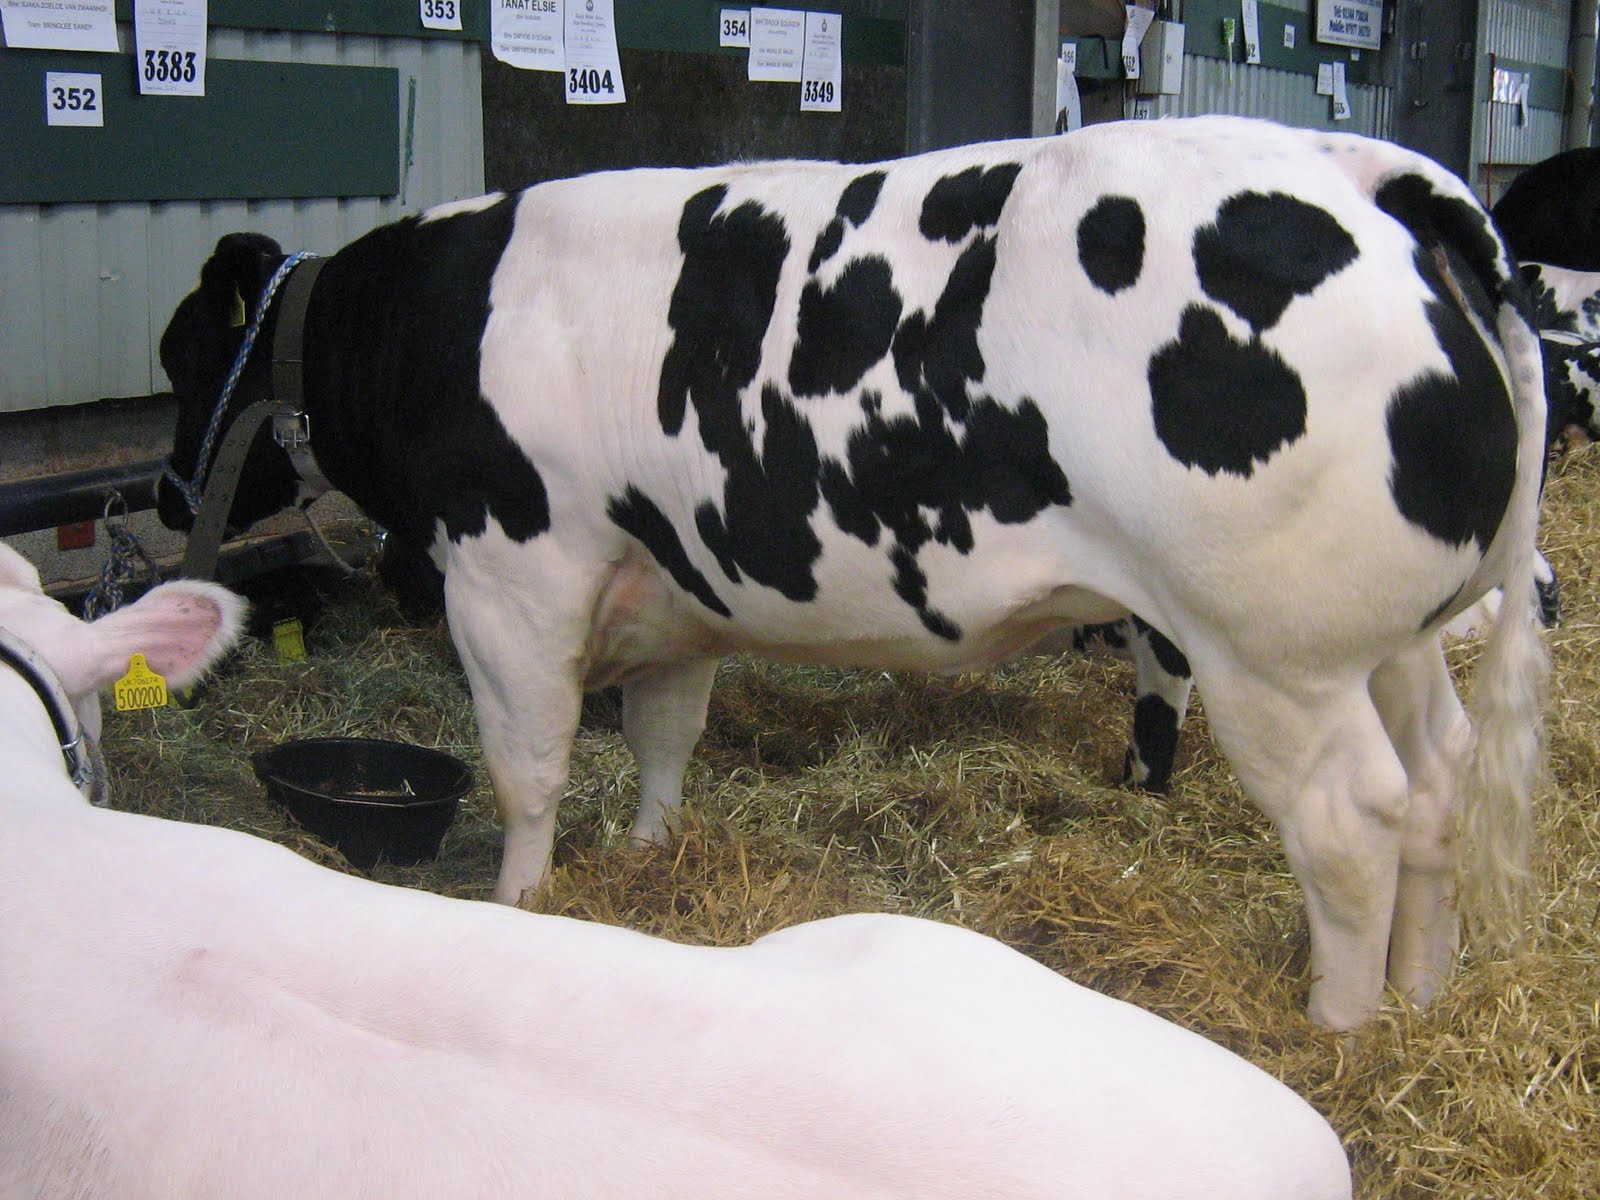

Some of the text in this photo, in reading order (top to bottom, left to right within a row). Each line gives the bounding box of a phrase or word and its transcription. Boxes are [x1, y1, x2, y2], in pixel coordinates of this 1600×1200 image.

[424, 0, 455, 20] 353
[501, 0, 557, 13] TANAT ELSIE
[723, 19, 746, 37] 354
[144, 49, 196, 83] 3383
[569, 68, 615, 94] 3404
[804, 80, 834, 103] 3349
[52, 86, 97, 111] 352
[119, 685, 163, 709] 500200
